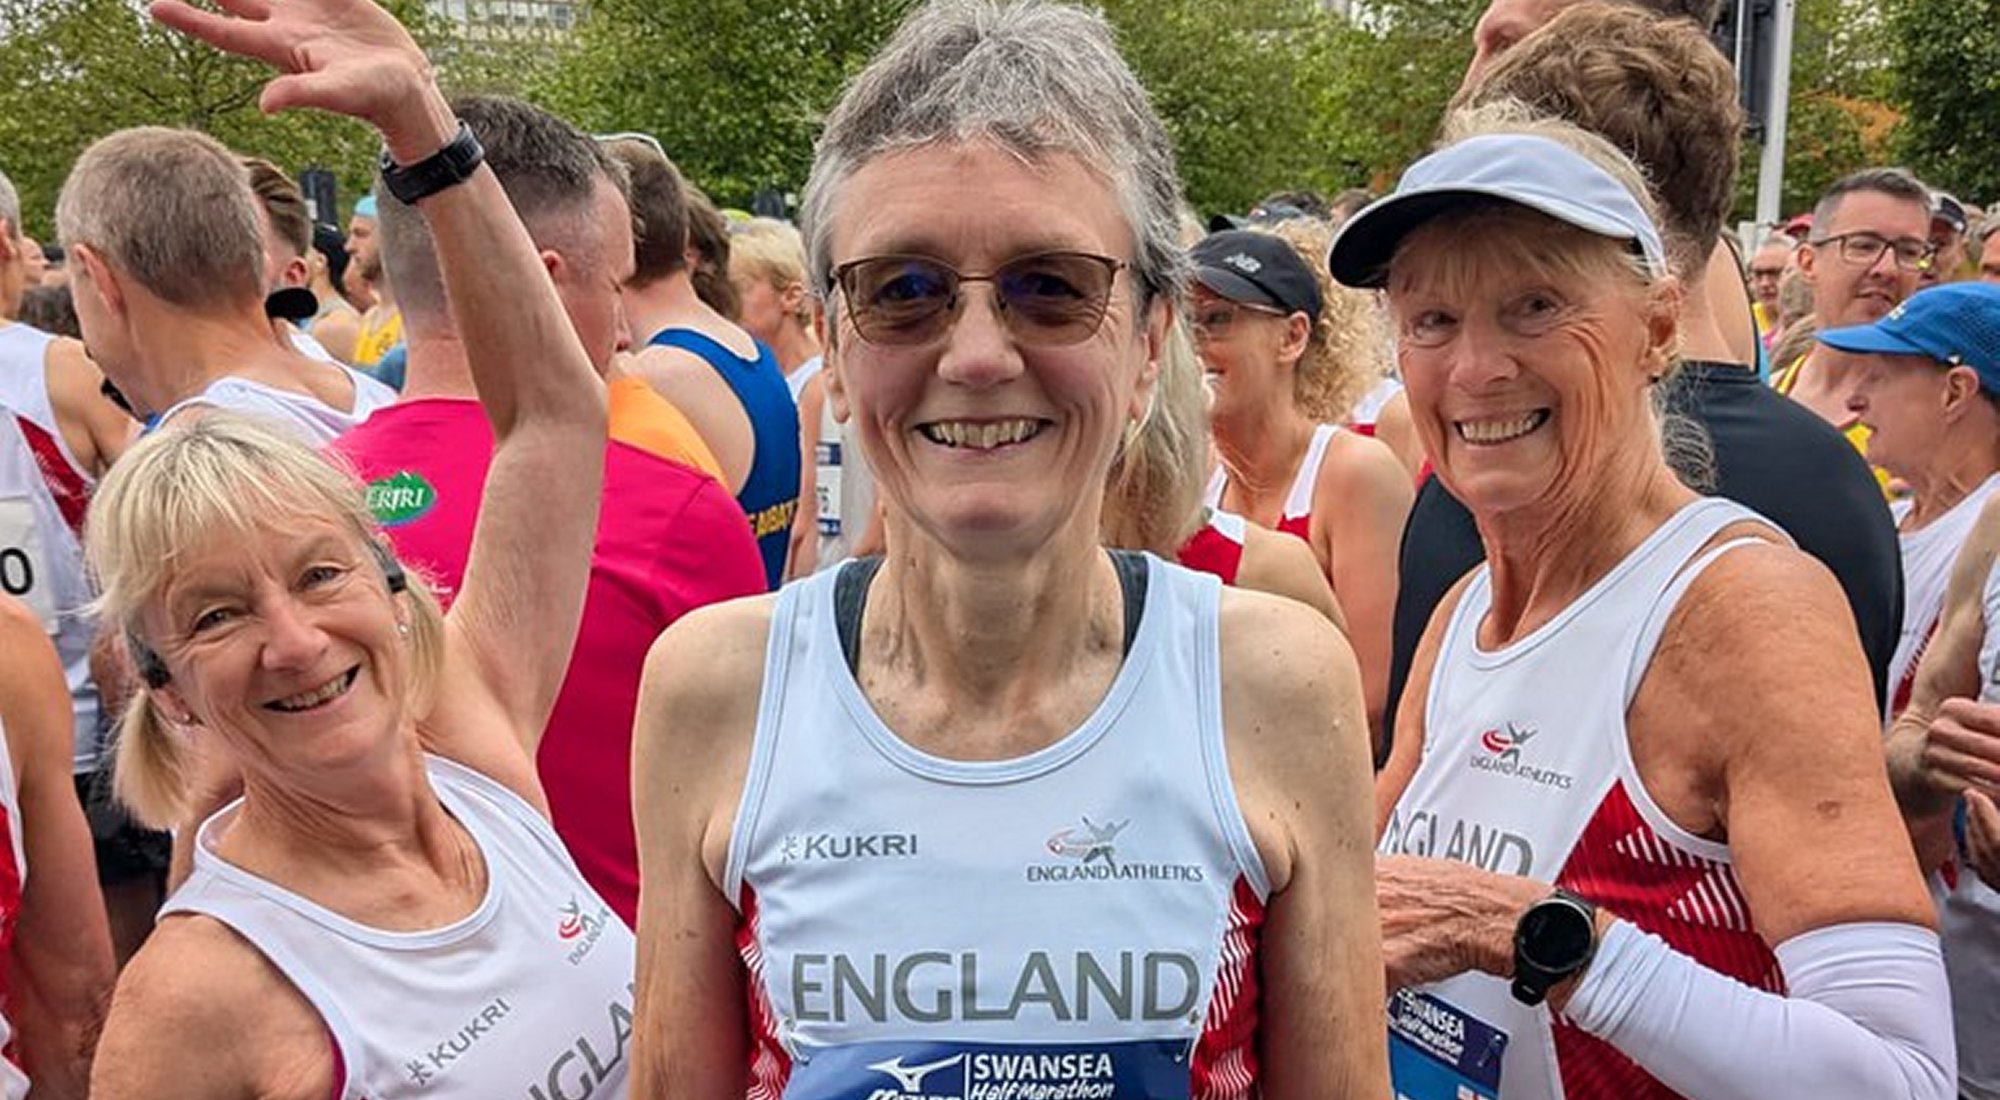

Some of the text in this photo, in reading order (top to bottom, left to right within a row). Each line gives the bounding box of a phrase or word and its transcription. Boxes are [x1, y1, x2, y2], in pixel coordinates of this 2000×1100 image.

[804, 833, 918, 860] KUKRI
[1027, 863, 1204, 883] ENGLAND ATHLETICS
[791, 950, 1200, 1023] ENGLAND
[427, 998, 511, 1069] KUKRI
[973, 1053, 1114, 1081] SWANSEA
[970, 1080, 1020, 1100] Half
[1017, 1078, 1116, 1100] Marathon
